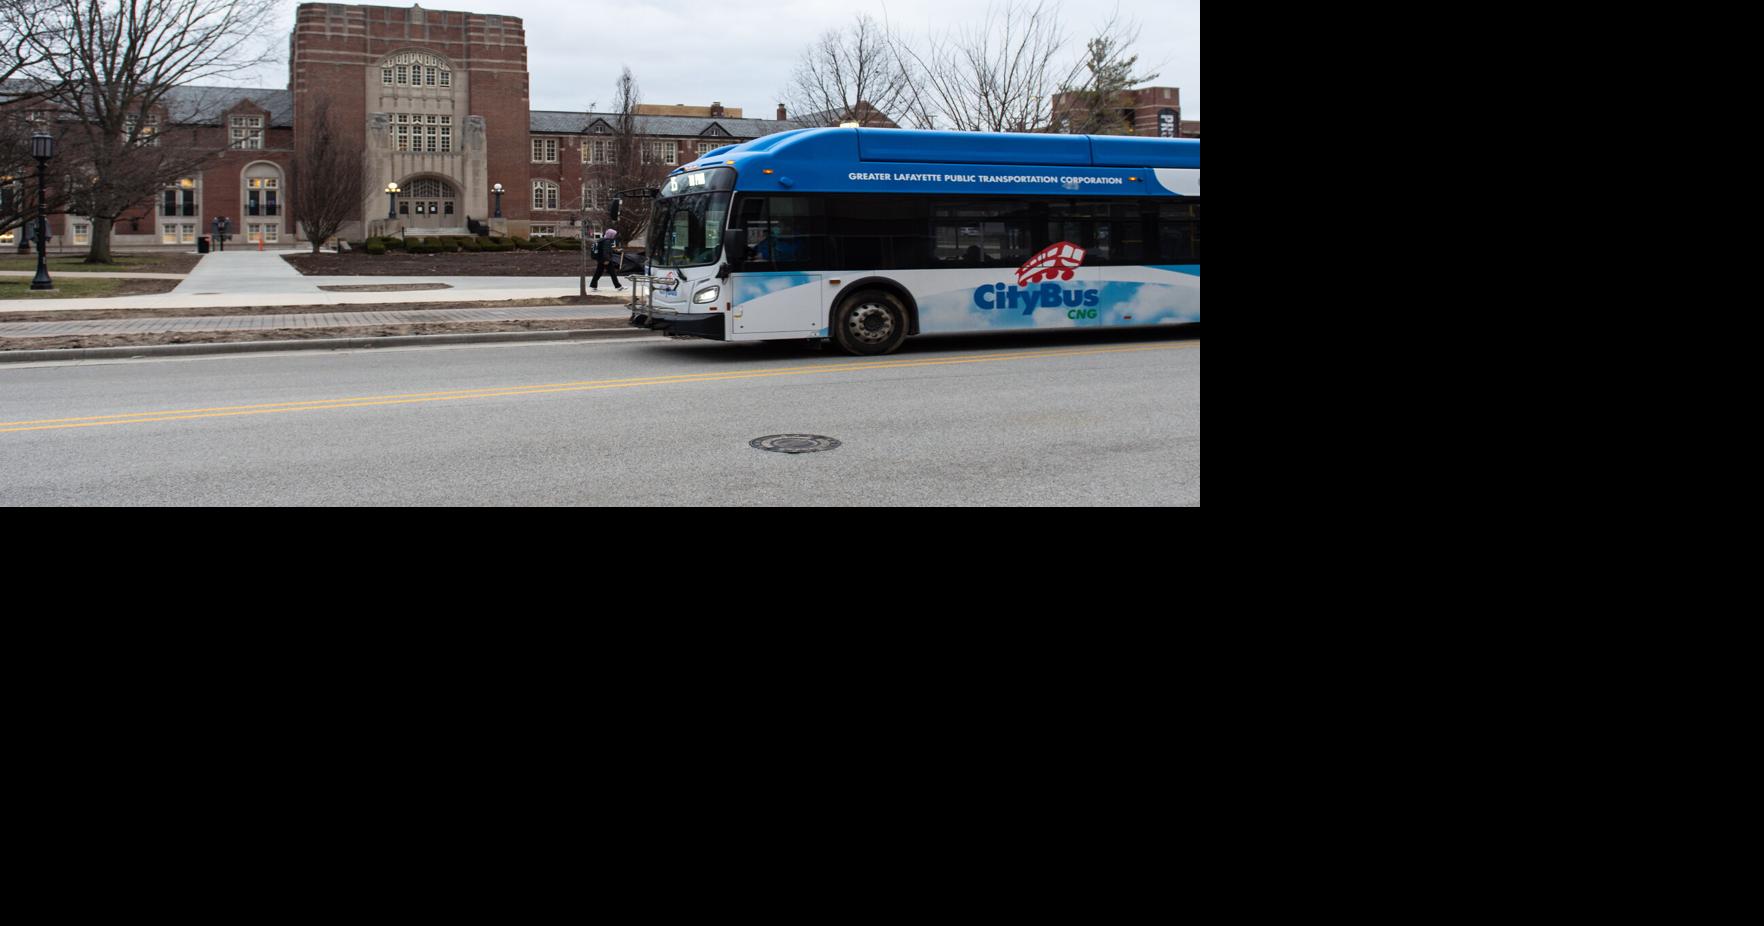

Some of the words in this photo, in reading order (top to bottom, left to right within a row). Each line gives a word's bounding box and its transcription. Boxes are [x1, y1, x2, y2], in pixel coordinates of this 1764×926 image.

[848, 172, 891, 181] GREATER
[894, 173, 942, 182] LAFAYETTE
[945, 174, 976, 182] PUBLIC
[978, 175, 1058, 183] TRANSPORTATION
[1060, 176, 1122, 184] CORPORATION
[974, 282, 1099, 316] CityBus
[1067, 309, 1098, 320] CNG
